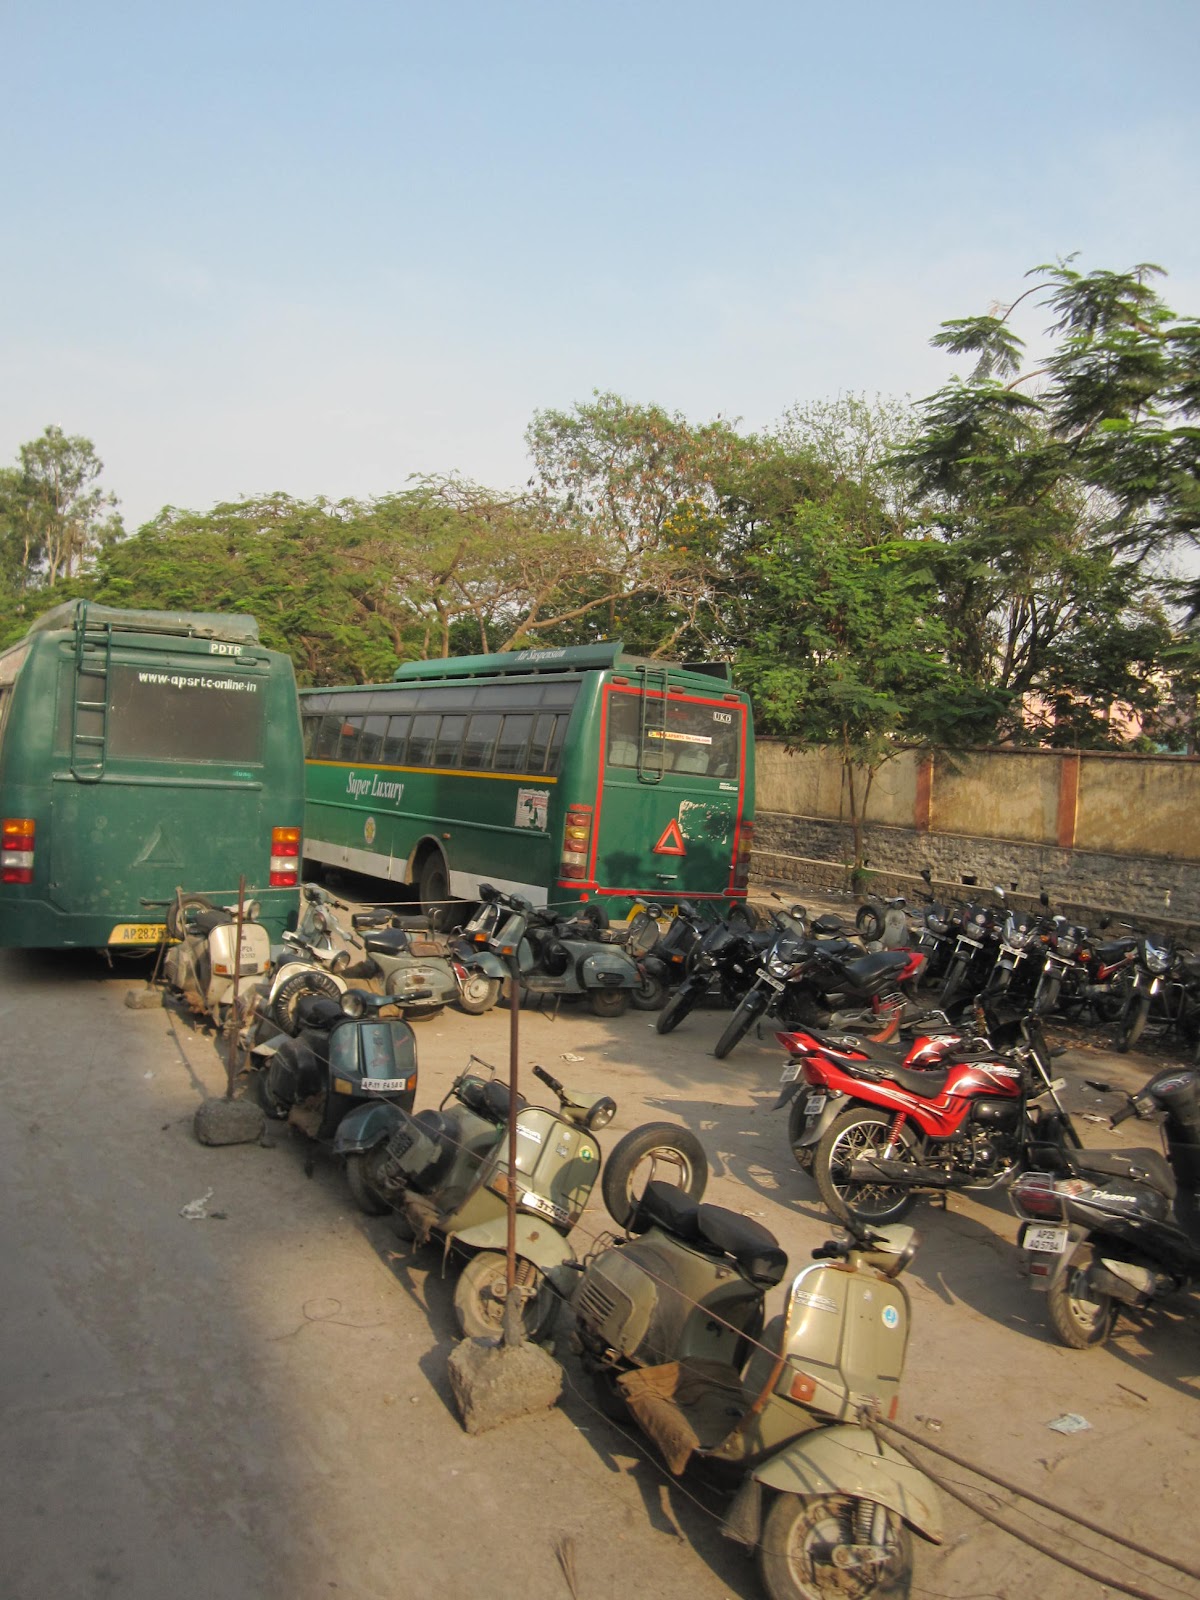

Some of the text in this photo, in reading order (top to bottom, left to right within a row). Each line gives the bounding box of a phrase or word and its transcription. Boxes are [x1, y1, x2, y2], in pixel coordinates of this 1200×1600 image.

[210, 643, 242, 656] PDTR
[713, 712, 731, 723] UKD
[346, 771, 405, 806] Super Luxury
[1092, 1189, 1137, 1203] Pleasure
